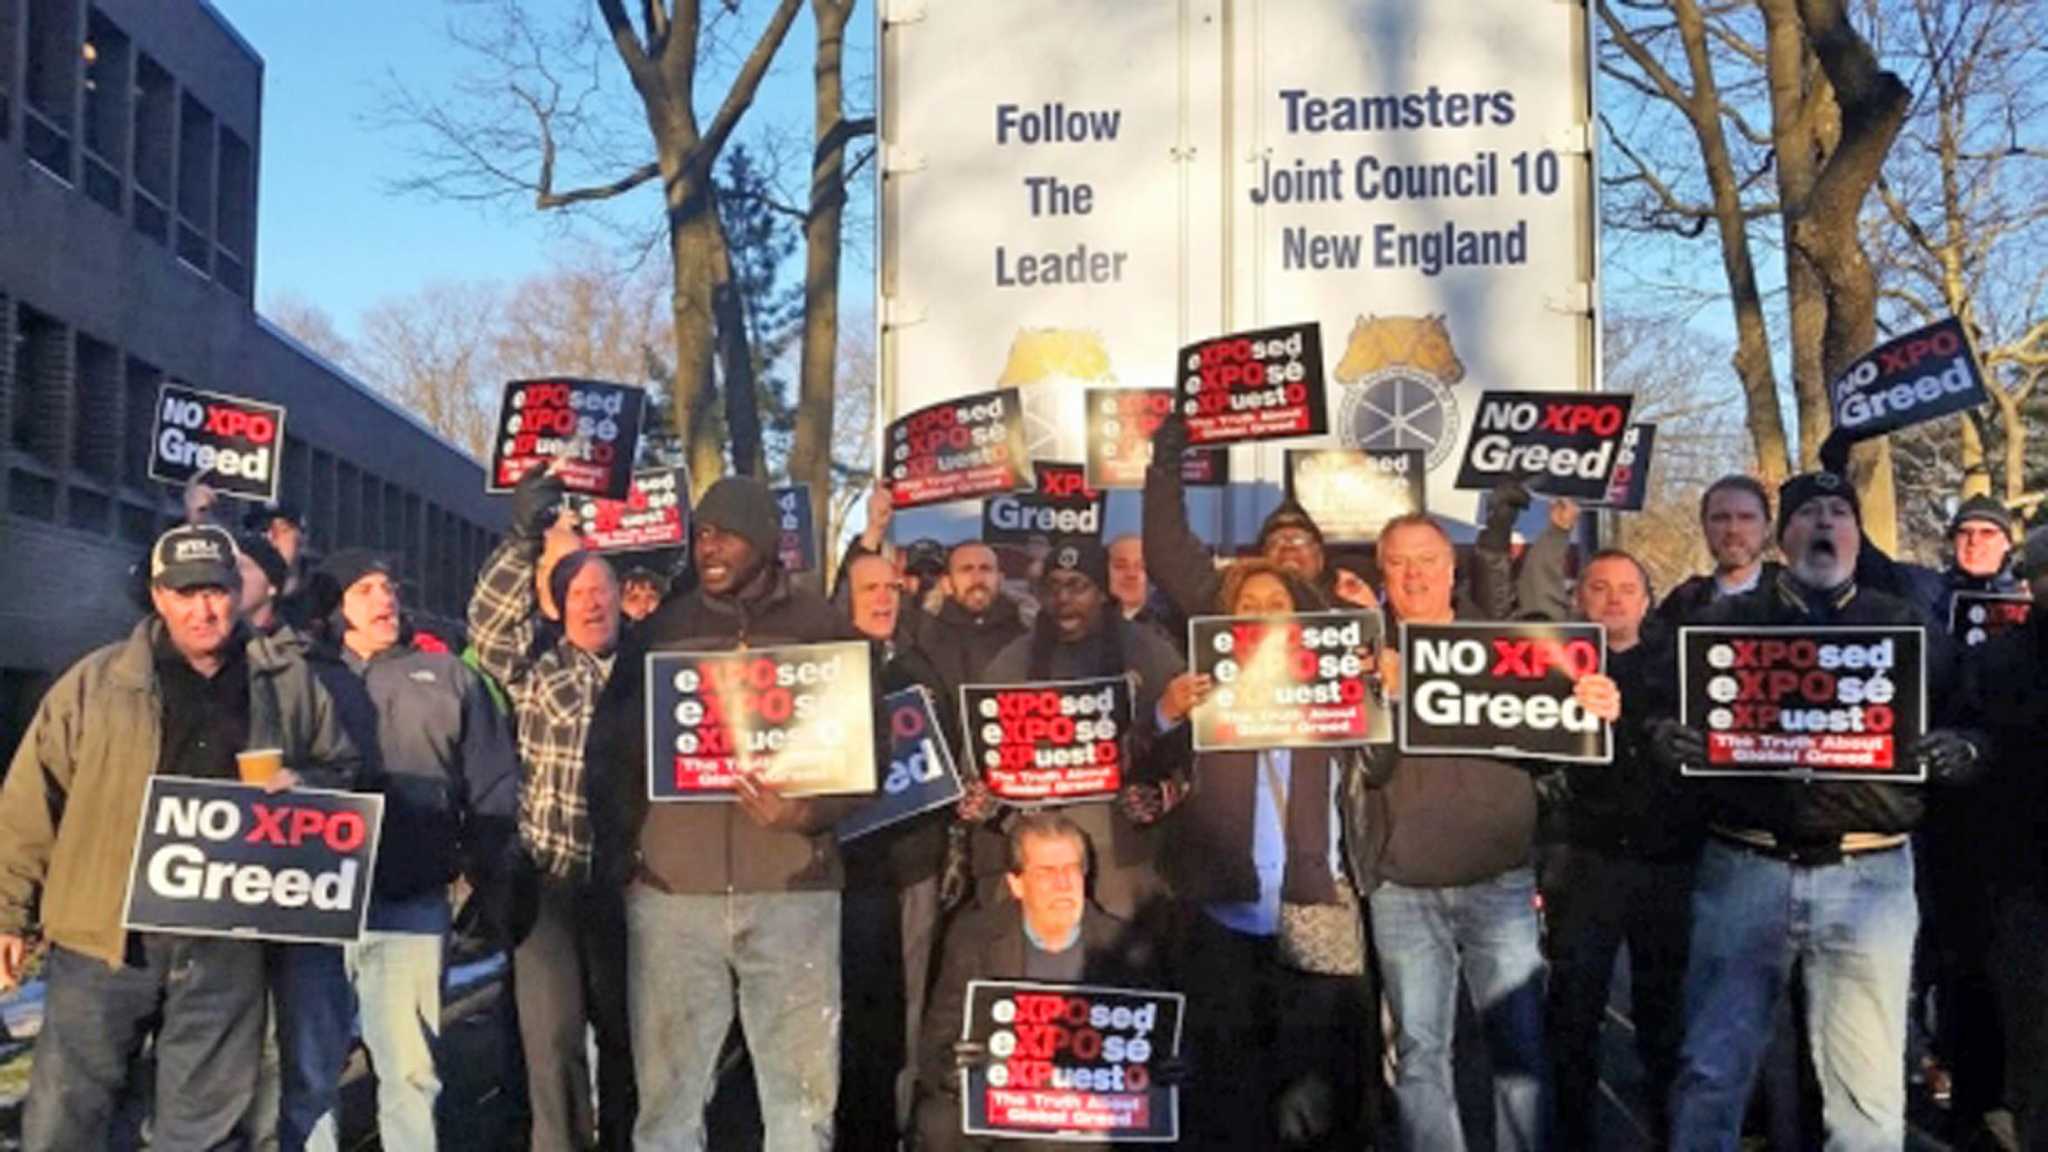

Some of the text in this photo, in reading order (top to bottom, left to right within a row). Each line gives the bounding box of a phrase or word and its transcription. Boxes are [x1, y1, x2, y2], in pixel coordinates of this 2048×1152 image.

[996, 105, 1121, 145] Follow
[1279, 87, 1516, 134] Teamsters
[1024, 176, 1093, 216] The
[1250, 149, 1559, 204] Joint Council 10
[995, 247, 1127, 288] Leader
[1282, 221, 1527, 276] New England
[1837, 361, 1879, 400] NO
[1840, 356, 1973, 427] Greed
[163, 398, 274, 443] NO XPO
[1481, 401, 1623, 436] NO XPO
[160, 428, 270, 482] Greed
[1470, 434, 1614, 480] Greed
[1040, 470, 1098, 498] XP
[989, 499, 1099, 534] Greed
[1413, 637, 1598, 680] NO XPO
[1413, 679, 1600, 733] Greed
[154, 796, 366, 853] NO XPO
[147, 844, 358, 911] Greed
